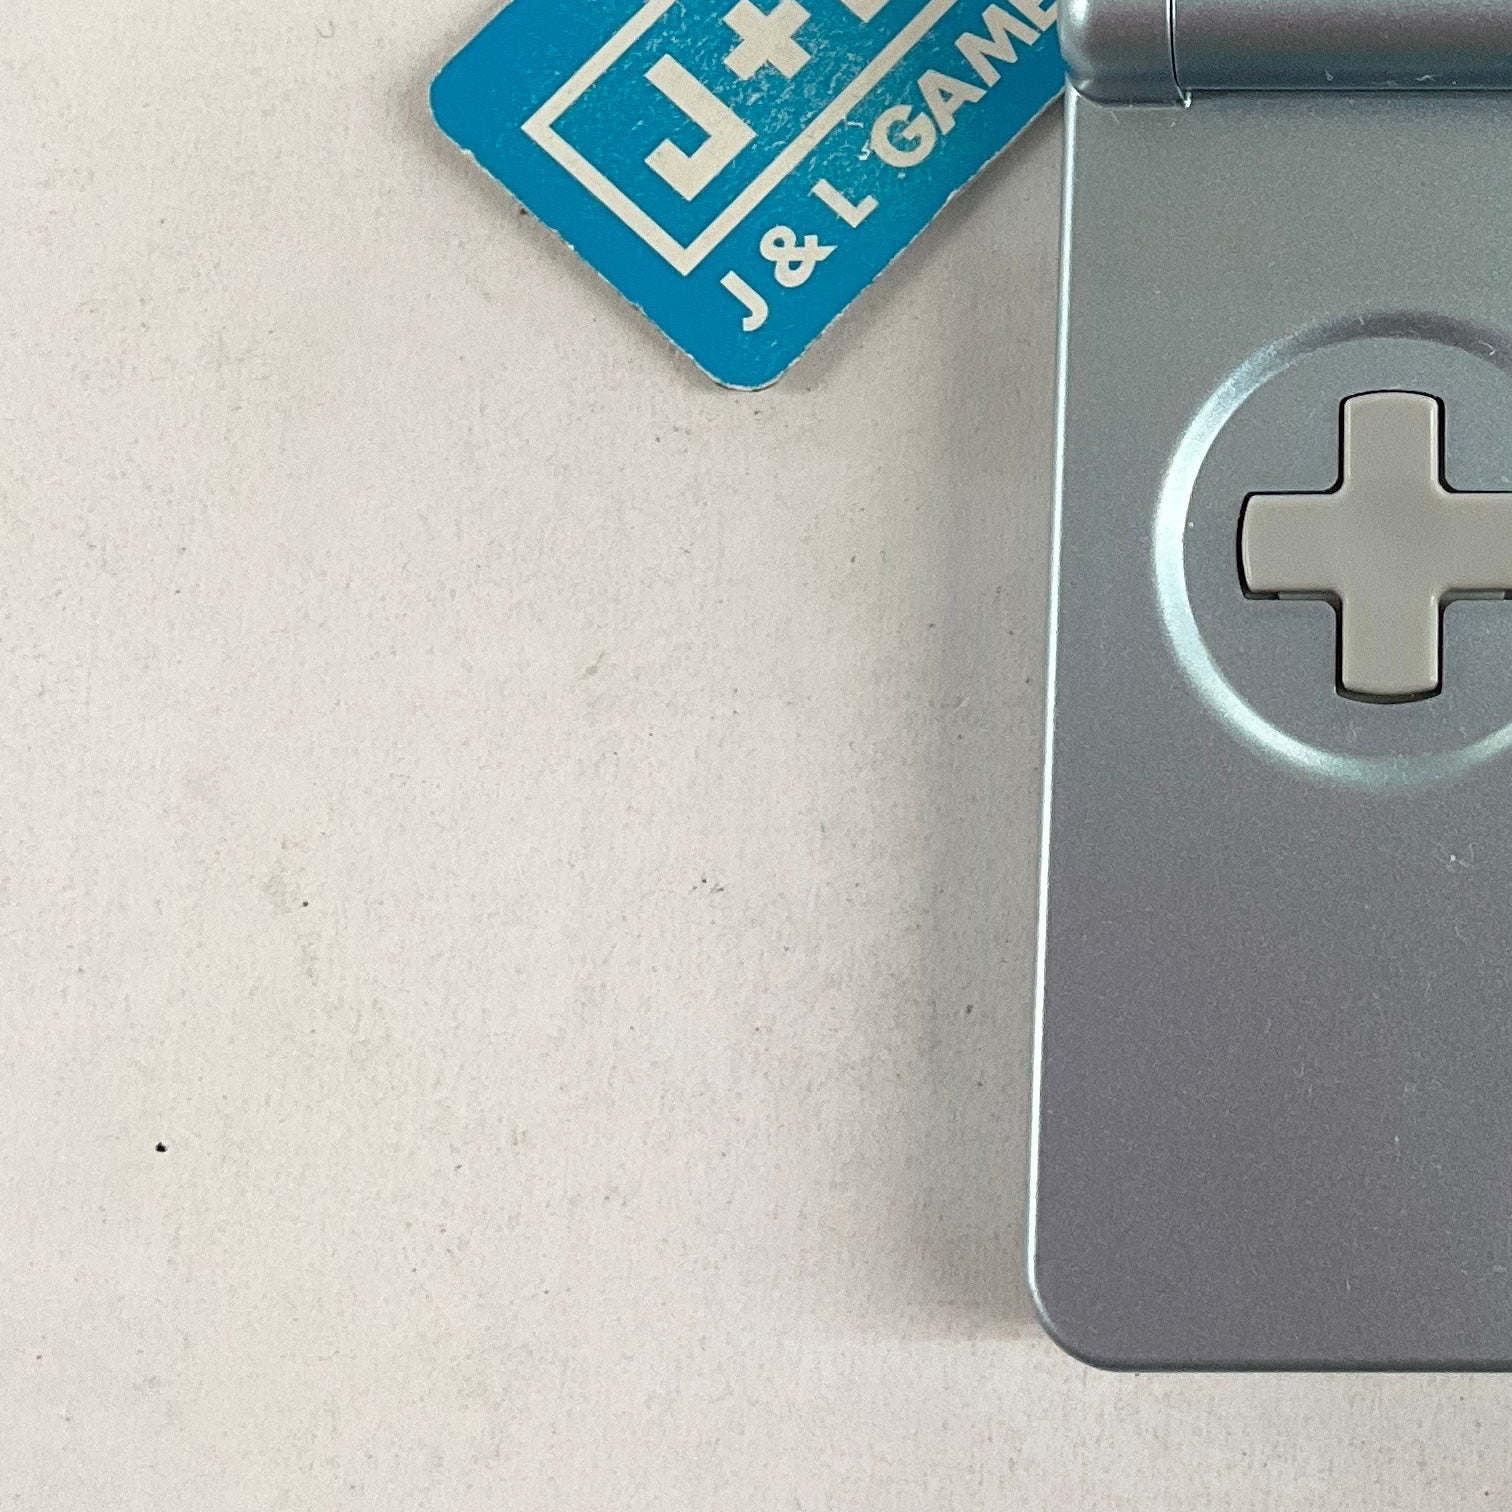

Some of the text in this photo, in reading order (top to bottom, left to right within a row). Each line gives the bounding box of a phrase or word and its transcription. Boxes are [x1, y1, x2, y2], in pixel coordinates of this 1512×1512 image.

[719, 270, 769, 332] J
[758, 224, 838, 289] &
[811, 177, 879, 228] L
